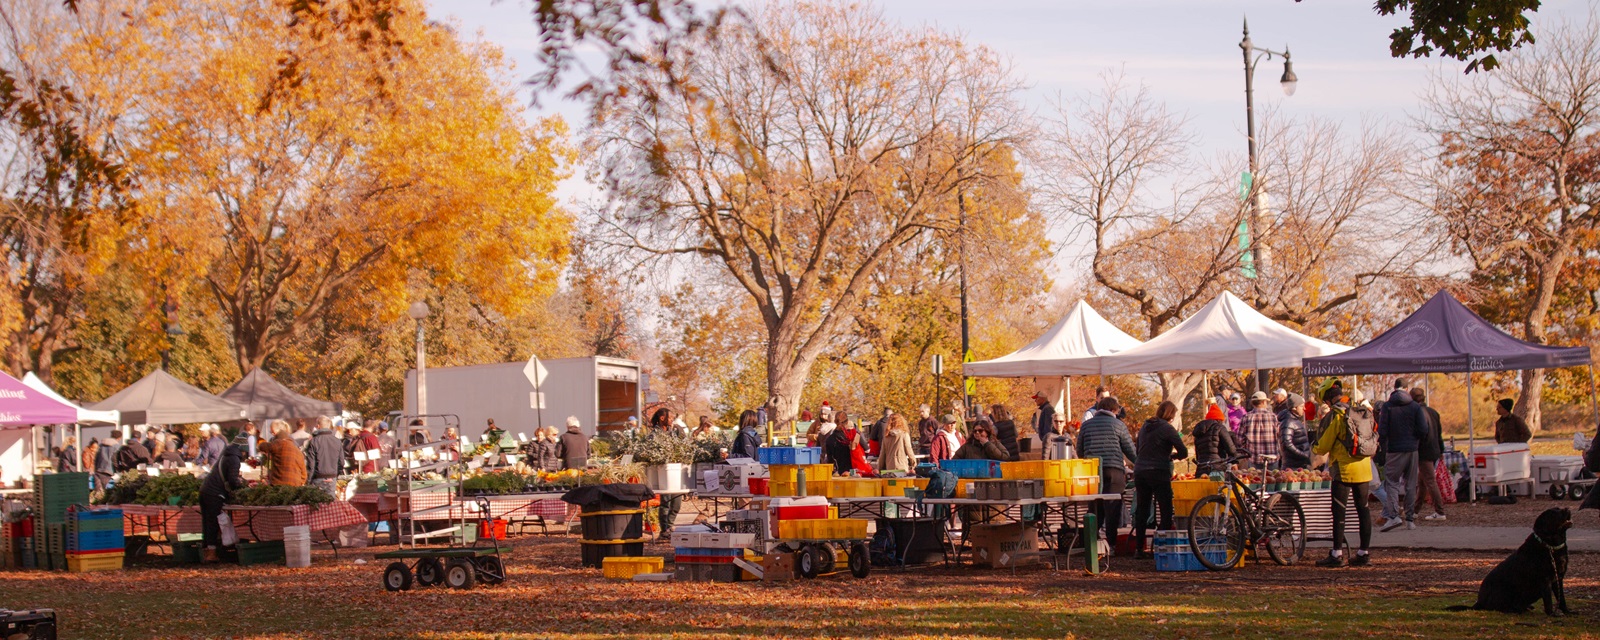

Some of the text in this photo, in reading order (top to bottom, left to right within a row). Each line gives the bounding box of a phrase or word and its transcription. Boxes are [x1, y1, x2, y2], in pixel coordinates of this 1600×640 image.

[1303, 362, 1345, 375] daisies
[1470, 356, 1504, 370] daisies
[1000, 541, 1019, 552] BERRY
